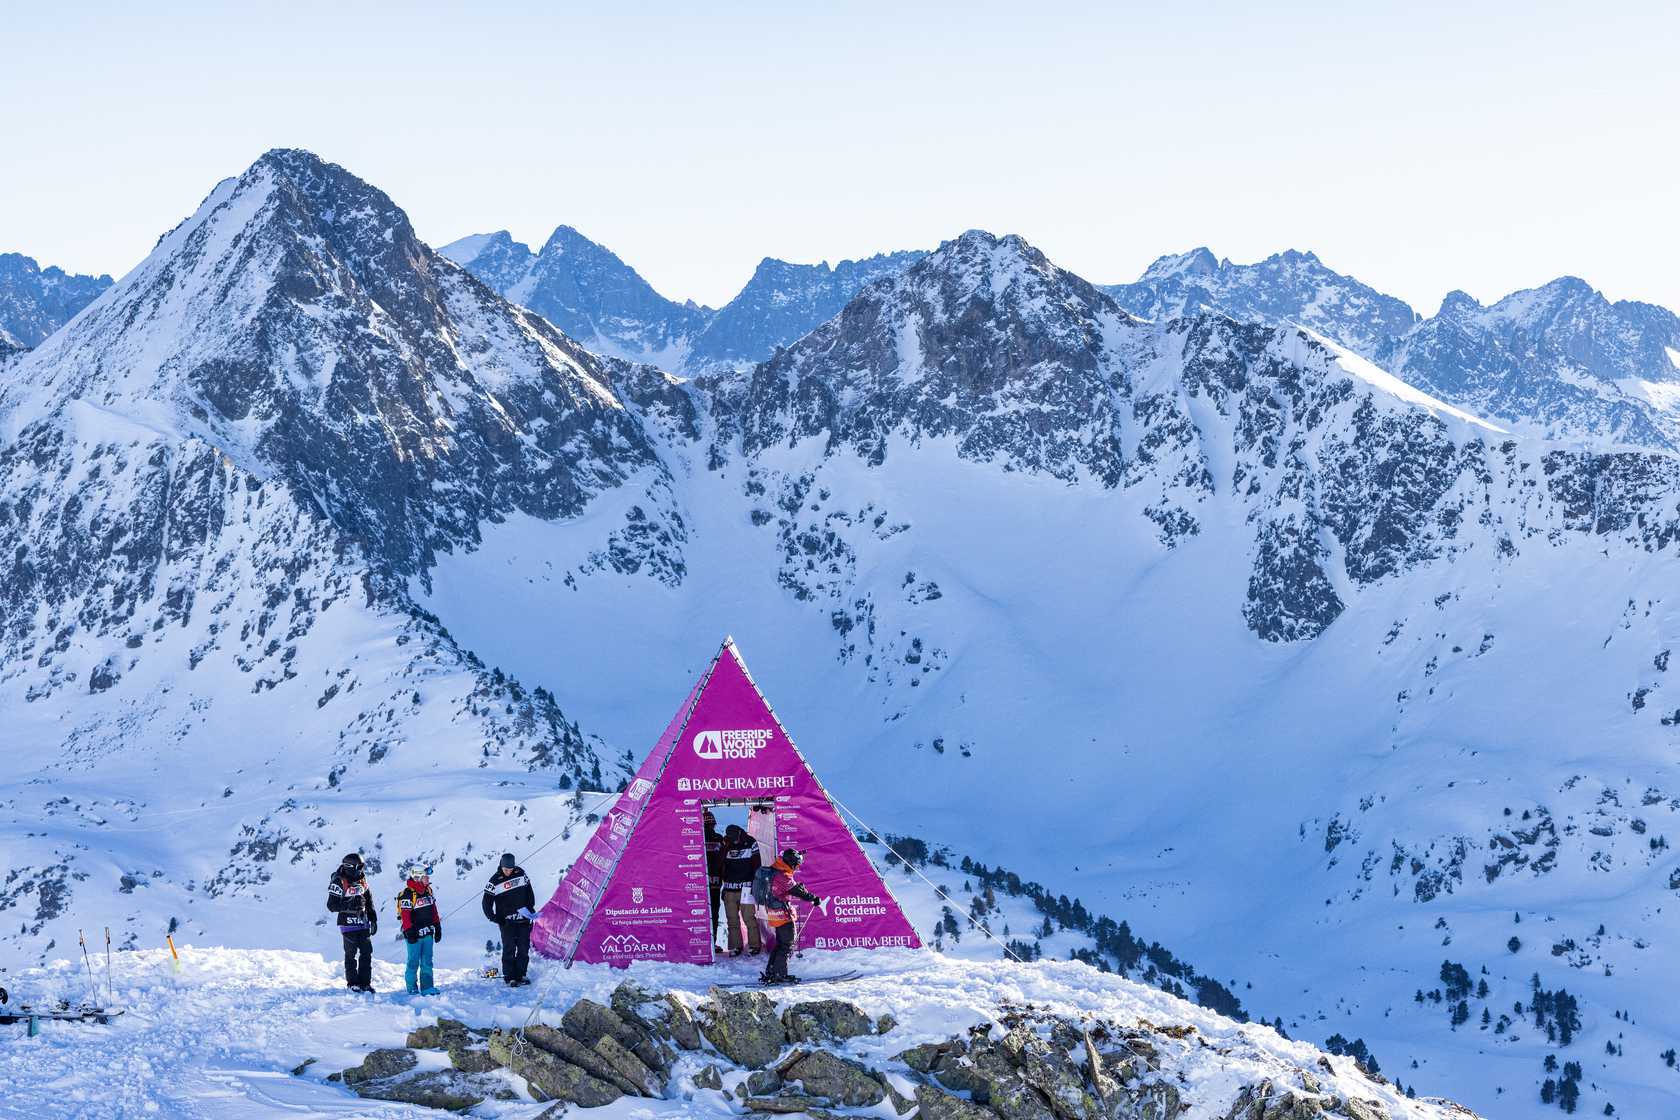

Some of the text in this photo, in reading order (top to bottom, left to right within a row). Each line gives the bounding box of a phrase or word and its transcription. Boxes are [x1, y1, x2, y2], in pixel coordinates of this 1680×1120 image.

[721, 729, 773, 740] FREERIDE
[722, 739, 767, 749] WORLD
[723, 749, 756, 759] TOUR
[692, 776, 796, 791] BAQUEIRA/BERET
[833, 895, 880, 906] Catalana
[605, 908, 639, 917] Diputació
[650, 906, 673, 914] Lleida
[834, 906, 887, 916] Occidente
[827, 936, 912, 948] BAQUEIRA/BERET
[600, 945, 622, 954] VAL
